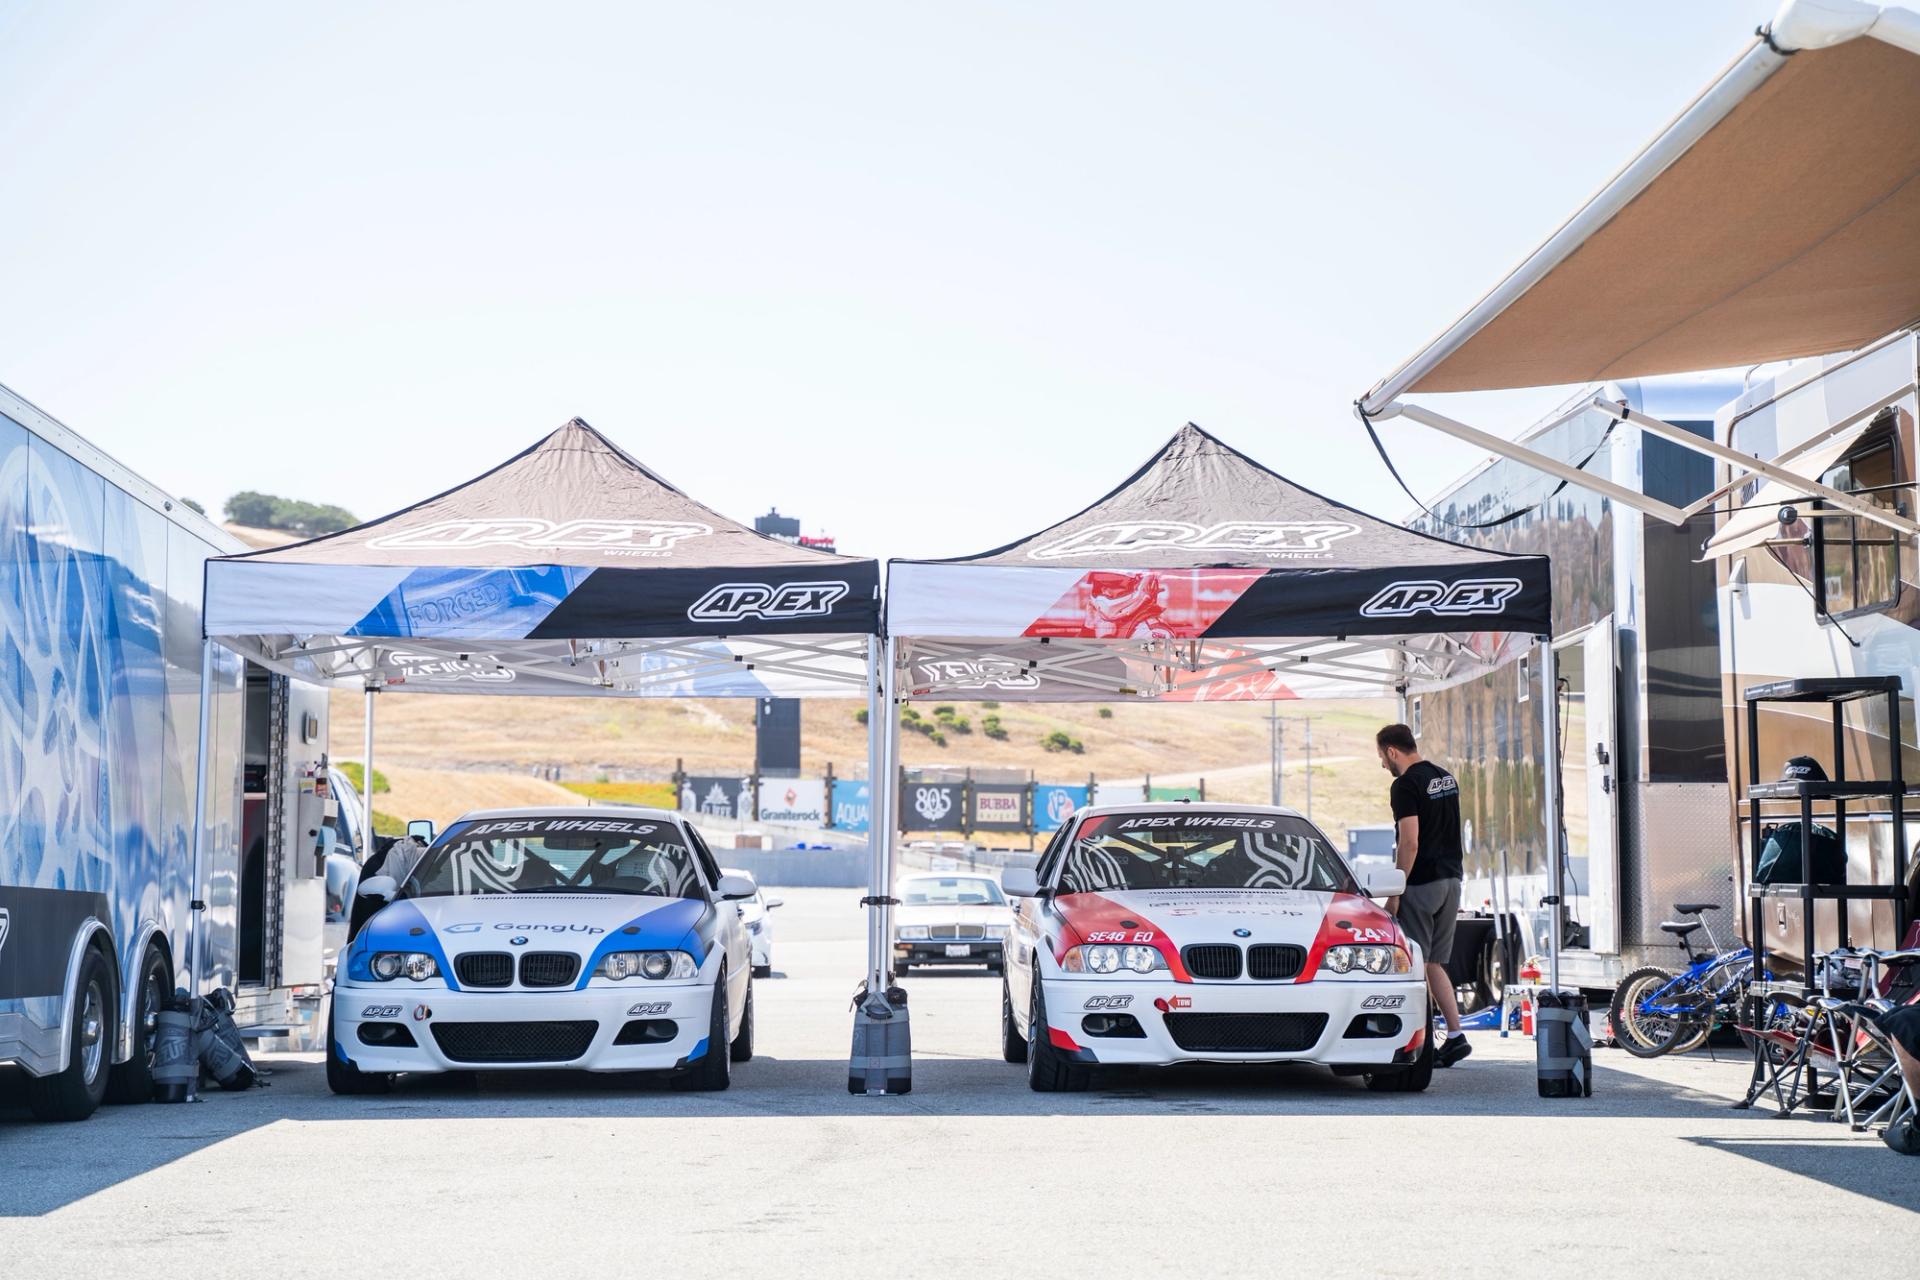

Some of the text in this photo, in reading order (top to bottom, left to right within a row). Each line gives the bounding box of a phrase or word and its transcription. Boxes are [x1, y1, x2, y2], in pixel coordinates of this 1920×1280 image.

[688, 582, 849, 621] APEX
[1361, 579, 1522, 616] APEX
[407, 582, 502, 629] FORGED
[915, 788, 951, 814] 805
[980, 798, 1017, 809] BUBBA
[761, 808, 820, 823] Graniterock
[1119, 817, 1277, 829] APEX WHEELS
[468, 820, 658, 835] APEX WHEELS
[494, 923, 605, 935] GangUp
[1087, 931, 1127, 942] SE46
[627, 1001, 673, 1016] APEX
[1084, 994, 1134, 1009] APEX
[1361, 995, 1406, 1009] APEX
[361, 1004, 403, 1018] APEX
